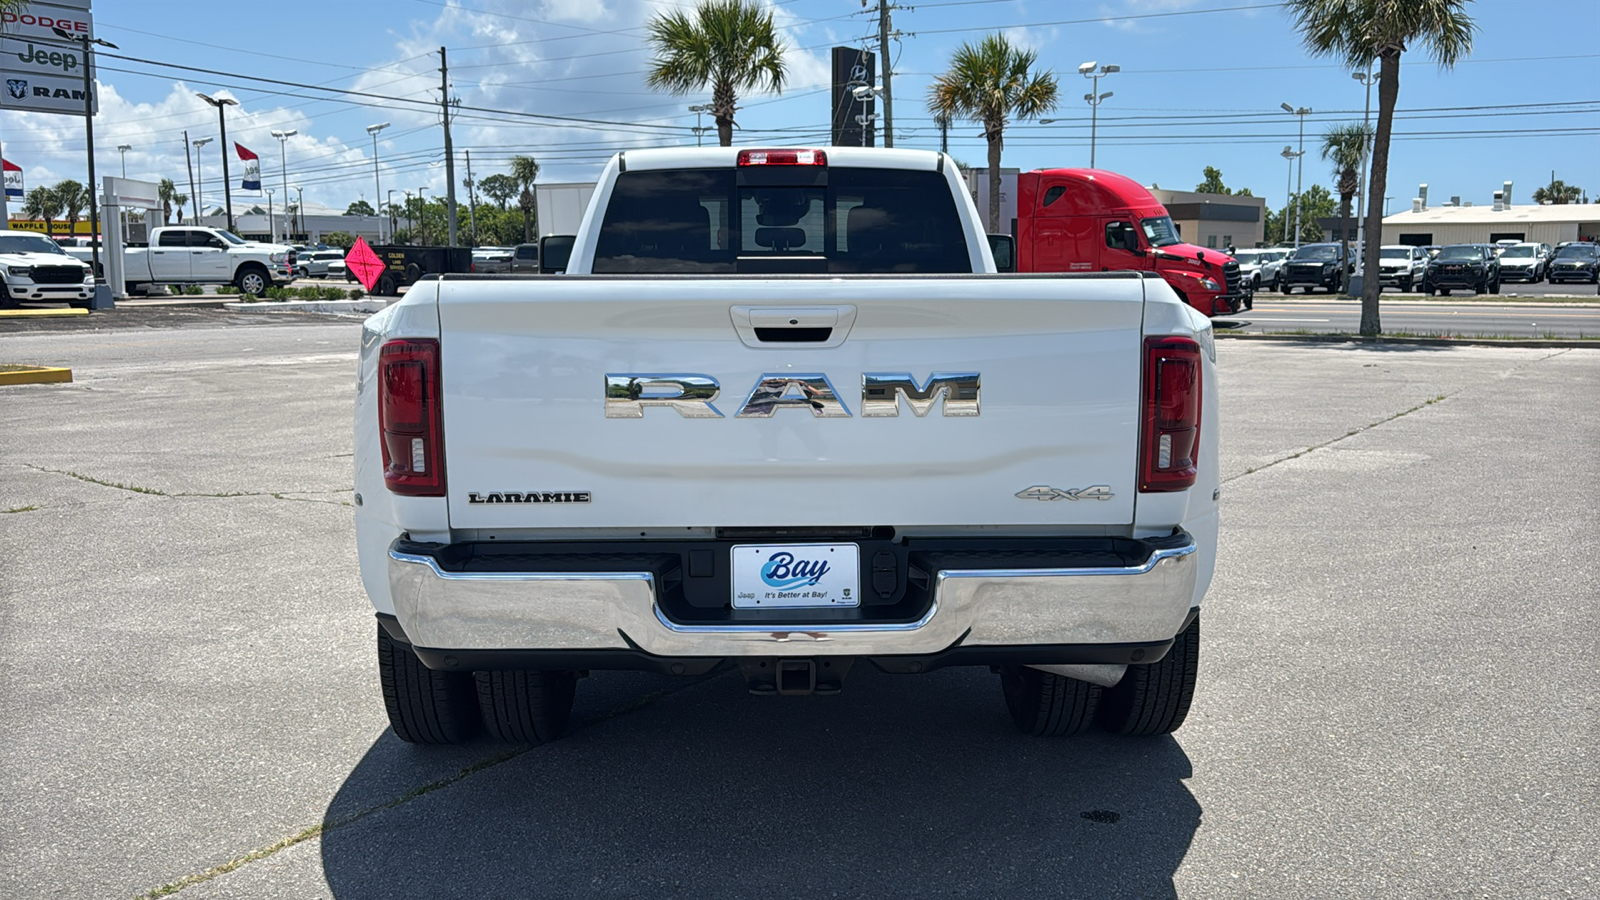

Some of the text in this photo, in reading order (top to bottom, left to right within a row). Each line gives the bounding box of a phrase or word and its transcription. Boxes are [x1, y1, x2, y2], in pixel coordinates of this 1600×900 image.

[2, 12, 89, 33] DODGE
[18, 44, 77, 71] Jeep
[33, 86, 92, 101] RAM
[605, 372, 981, 419] RAM
[468, 491, 592, 504] LARAMIE
[1014, 485, 1115, 501] 4x4
[766, 551, 831, 586] Bay
[778, 591, 801, 599] Better
[811, 591, 828, 599] Bay!
